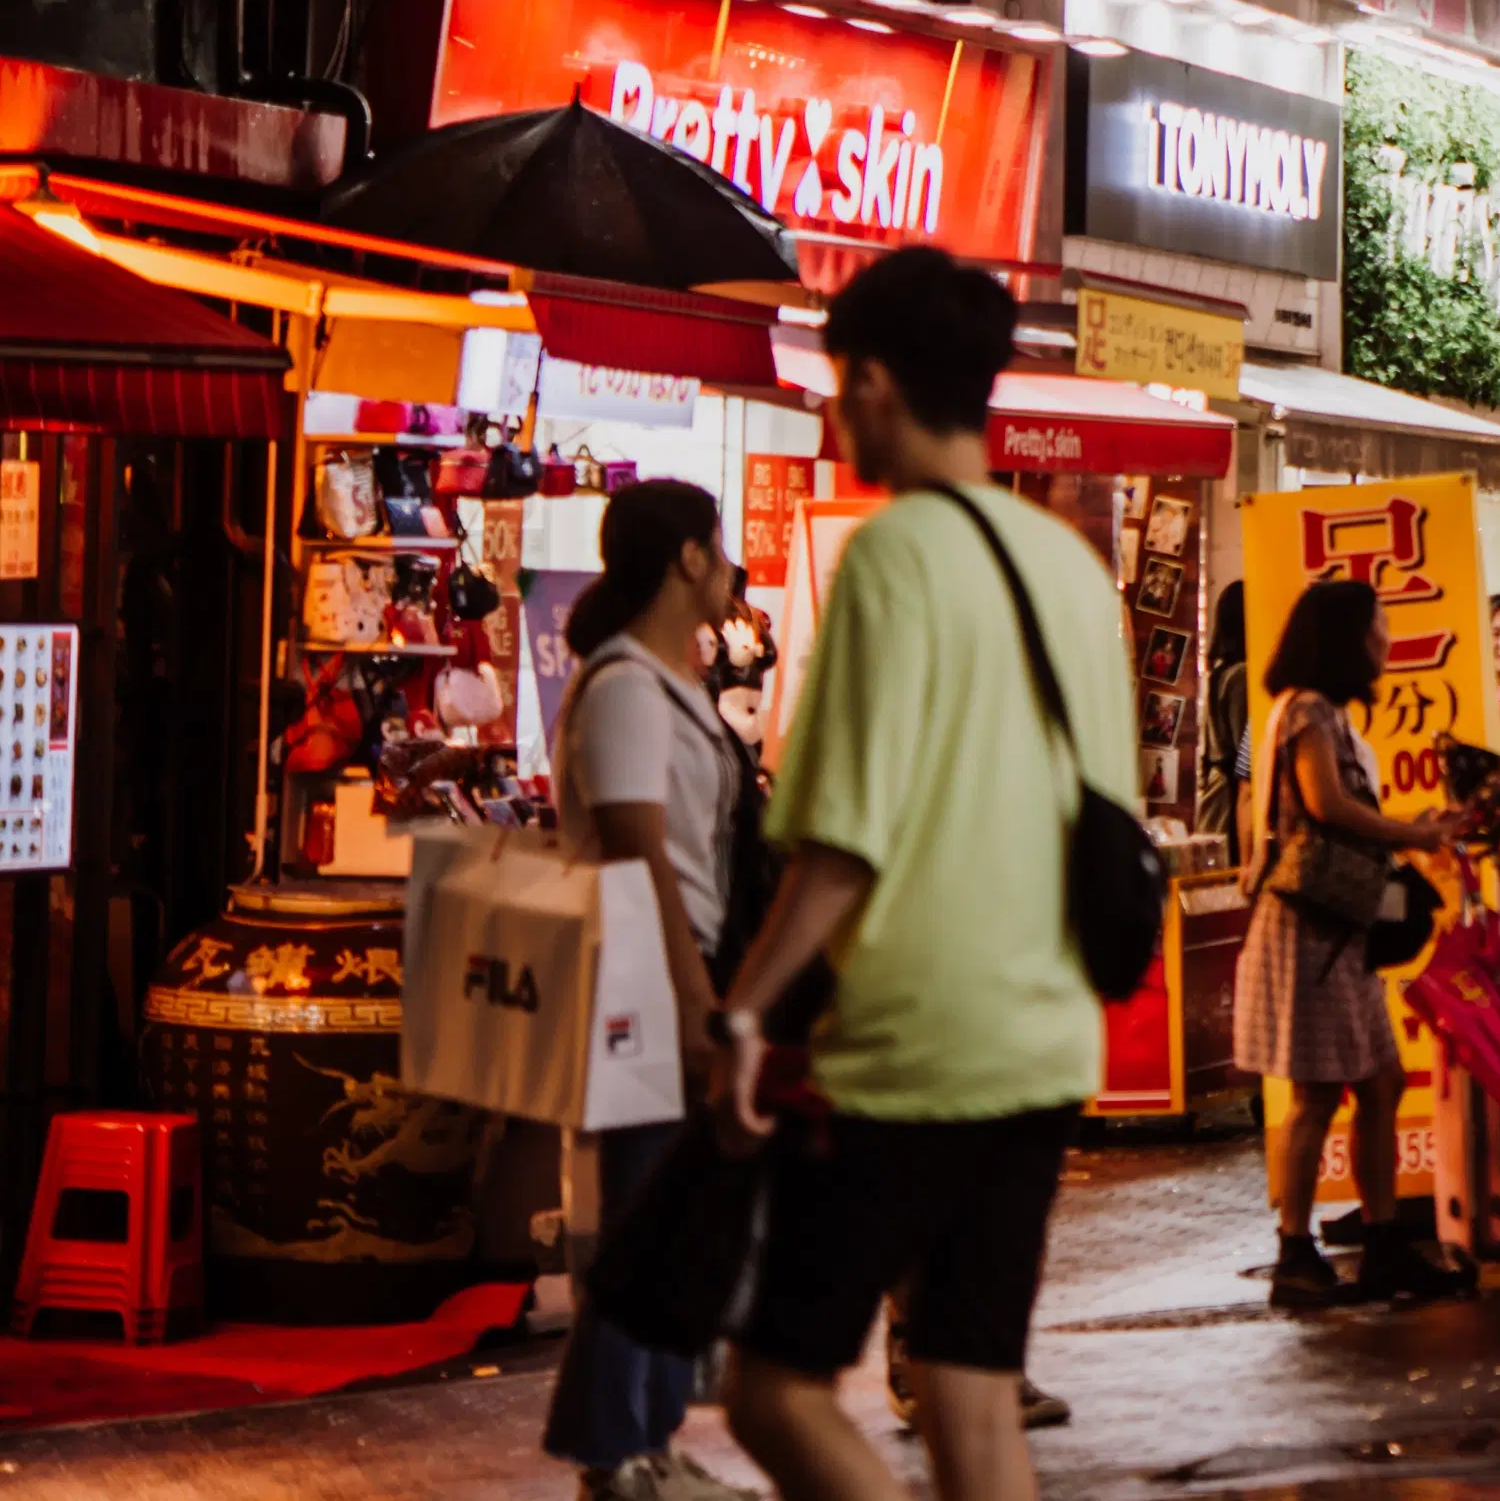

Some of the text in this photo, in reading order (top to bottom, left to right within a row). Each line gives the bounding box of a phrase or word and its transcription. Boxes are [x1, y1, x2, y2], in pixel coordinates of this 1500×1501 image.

[829, 103, 944, 234] skin
[1148, 101, 1328, 221] TONYMOLY
[463, 954, 541, 1014] FILA
